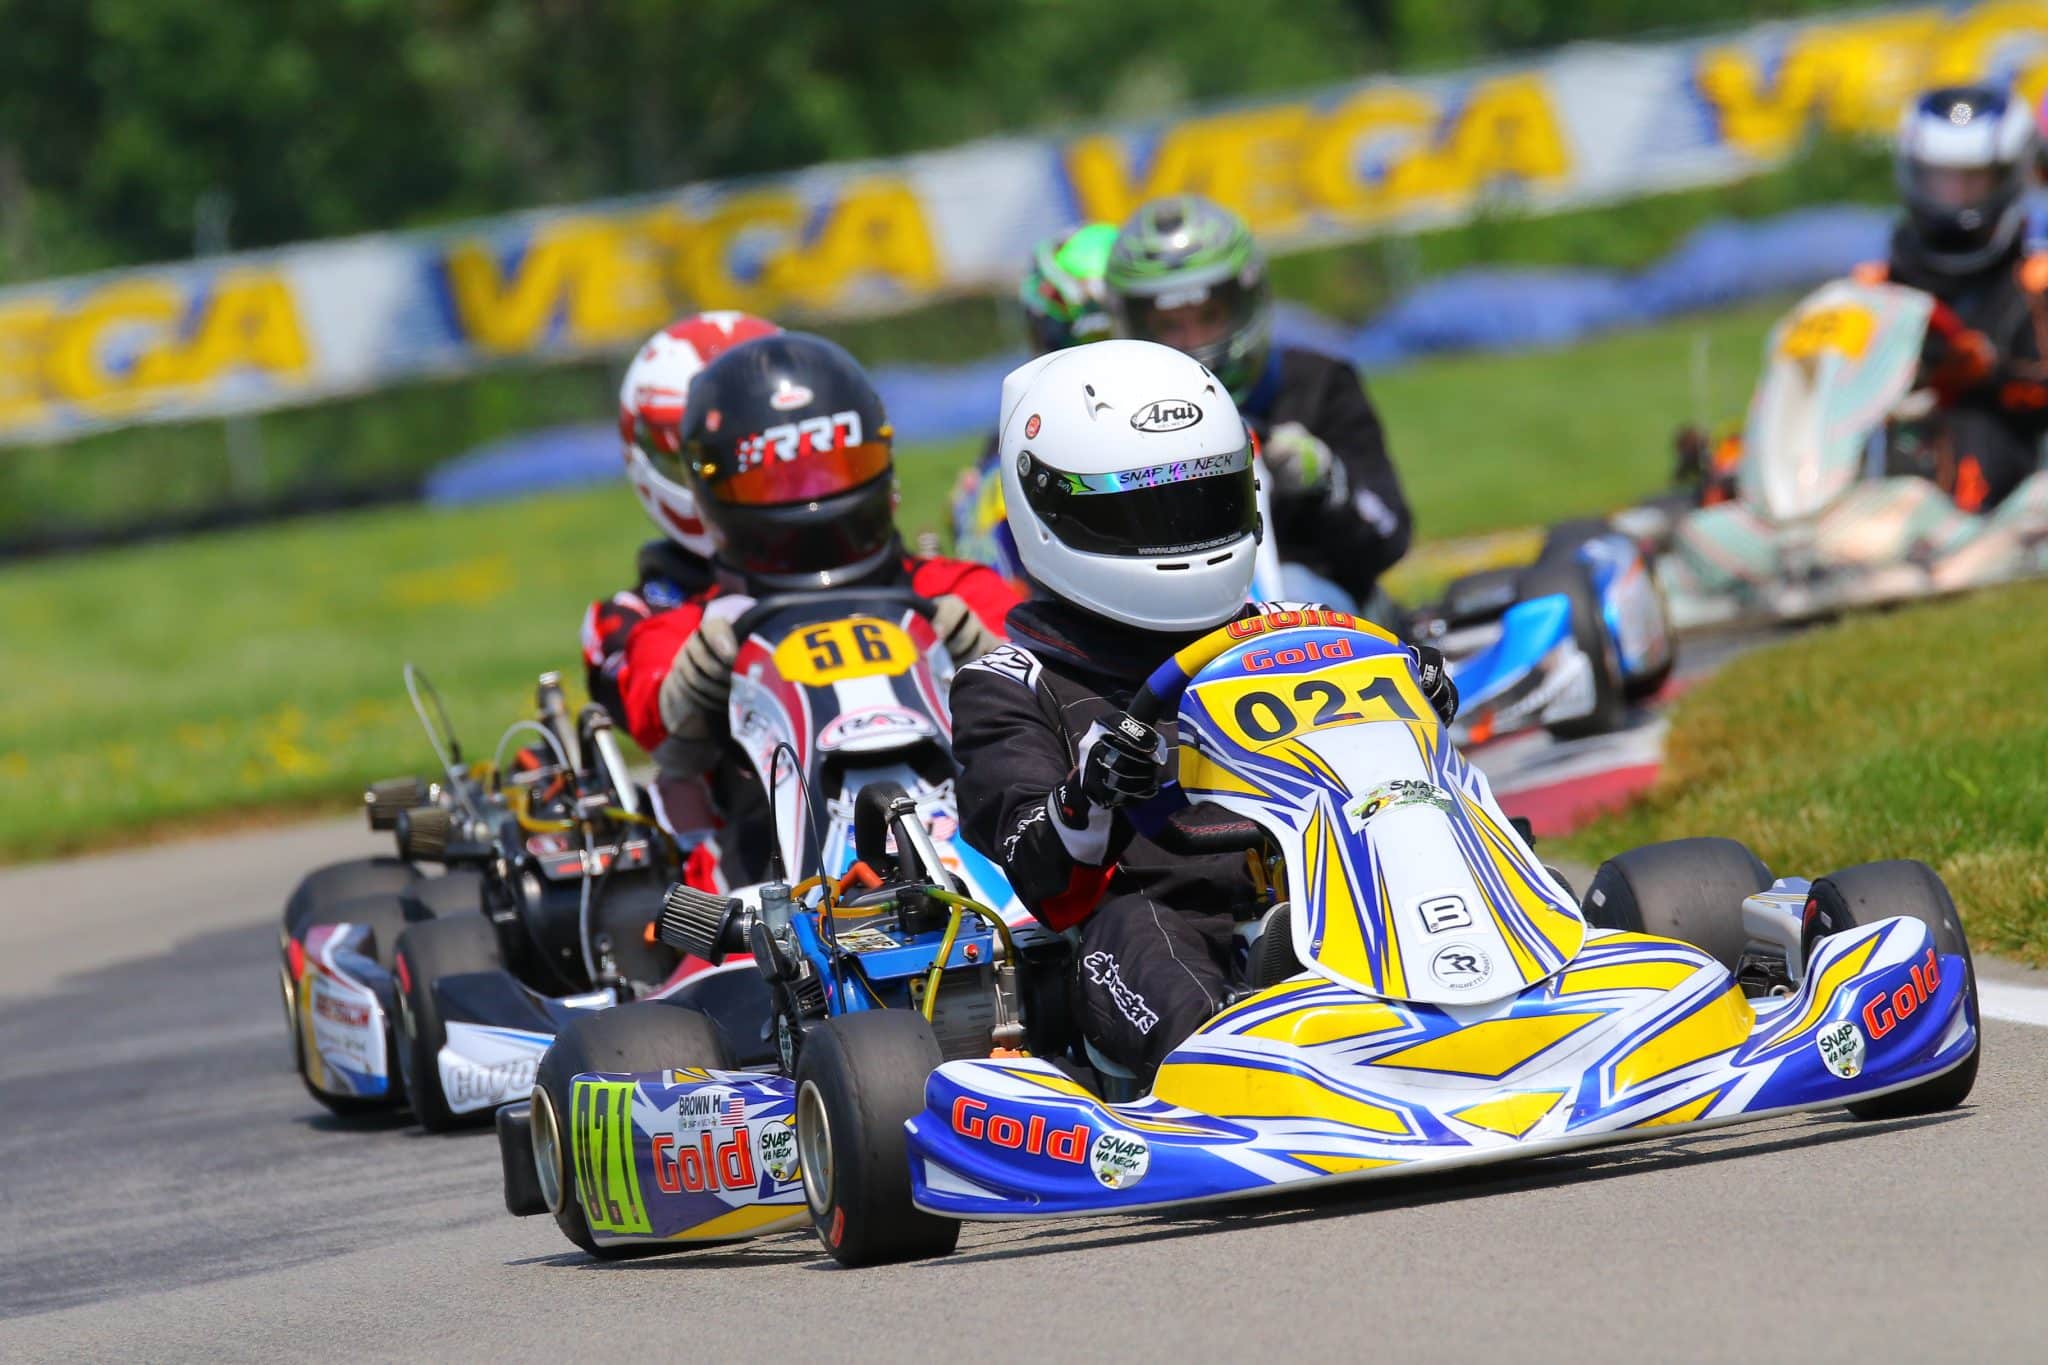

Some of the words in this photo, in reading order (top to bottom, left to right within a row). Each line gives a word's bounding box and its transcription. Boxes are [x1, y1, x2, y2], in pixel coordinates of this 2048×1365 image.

[1066, 70, 1571, 235] VEGA
[448, 172, 940, 354] VEGA
[1136, 402, 1197, 430] Arai
[1119, 467, 1163, 484] SNAP
[1194, 454, 1233, 471] NECK
[803, 624, 892, 672] 56
[1241, 638, 1354, 672] Gold
[1234, 677, 1421, 742] 021
[1119, 717, 1147, 741] OMP
[1862, 947, 1941, 1040] Gold
[1819, 1023, 1853, 1053] SNAP
[1838, 1039, 1858, 1057] NECK
[679, 1095, 710, 1117] BROWN
[761, 1131, 792, 1150] SNAP
[952, 1095, 1091, 1165] Gold
[652, 1126, 757, 1194] Gold
[772, 1147, 793, 1160] NECK
[1099, 1134, 1146, 1157] SNAP
[1111, 1156, 1140, 1170] NECK
